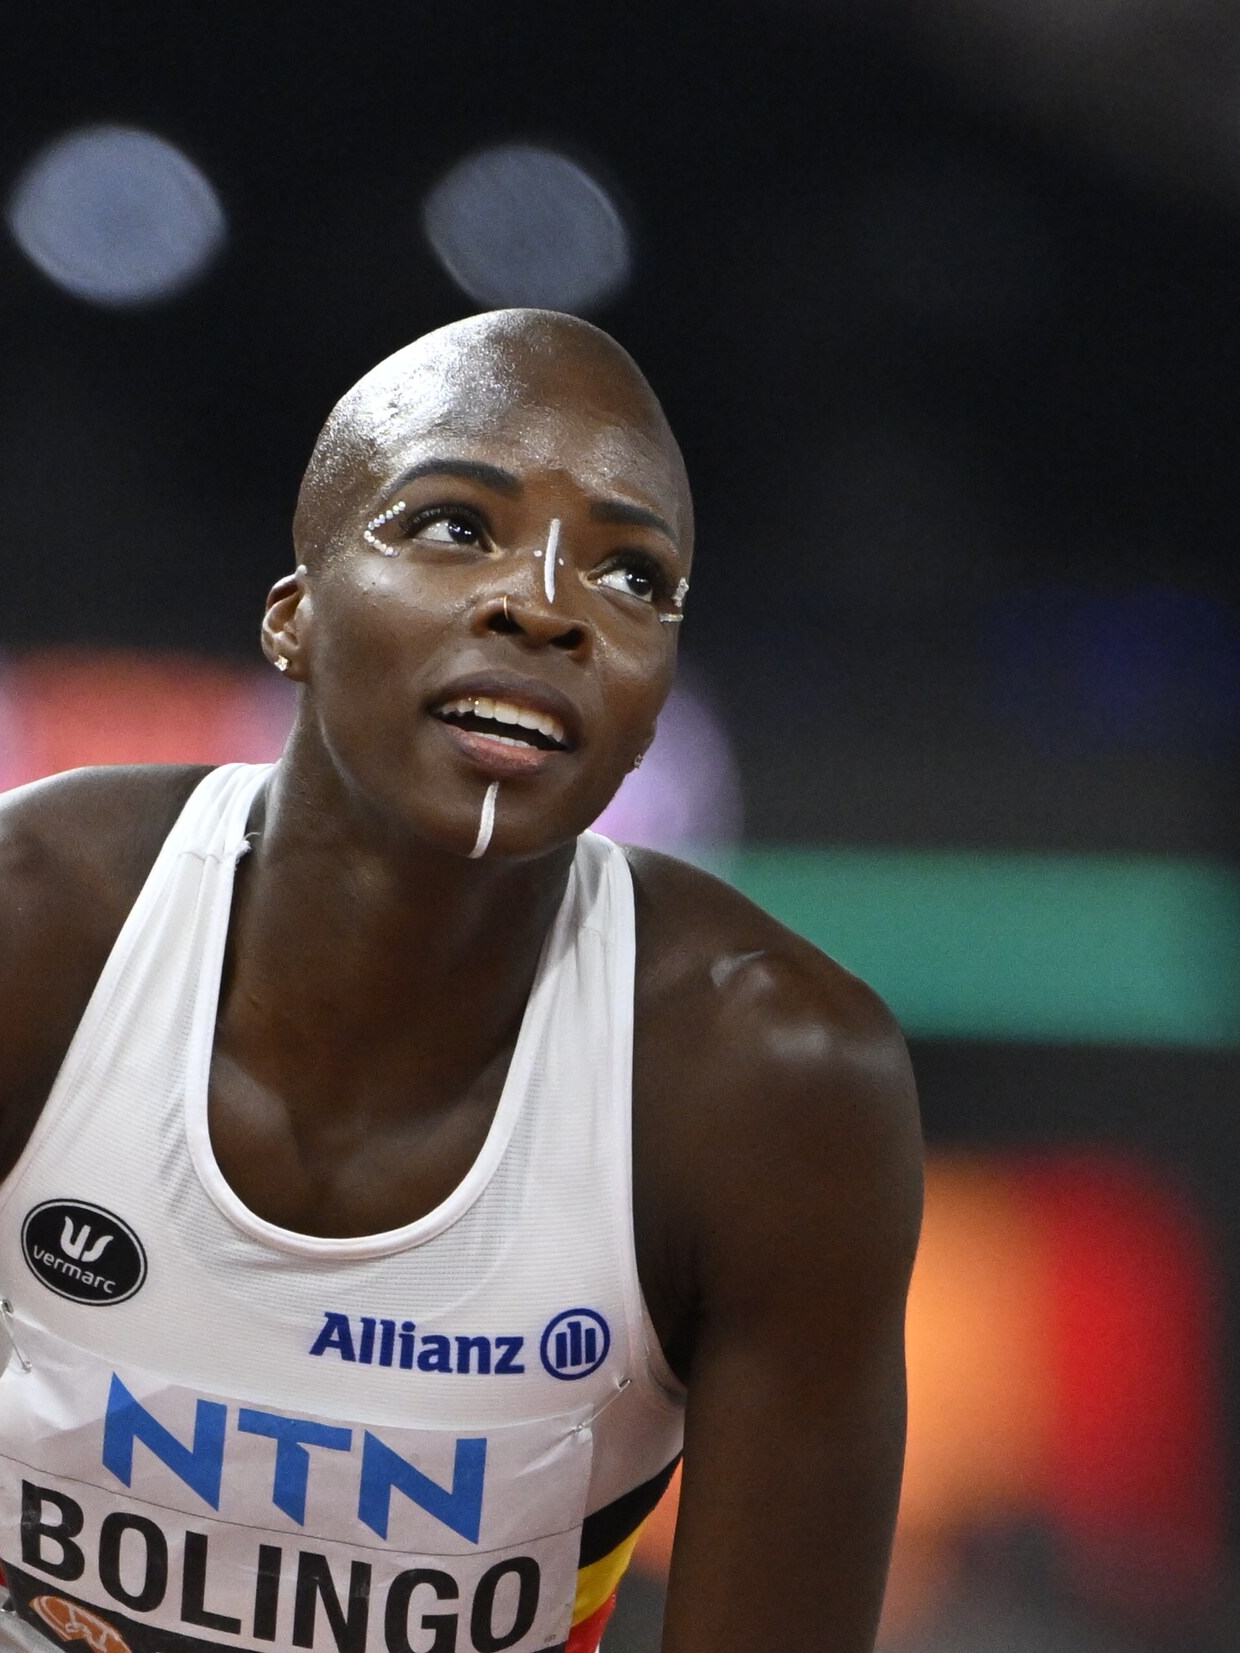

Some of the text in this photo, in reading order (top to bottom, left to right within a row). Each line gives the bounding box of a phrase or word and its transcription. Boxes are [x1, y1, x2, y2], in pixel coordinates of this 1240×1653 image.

[32, 1245, 116, 1293] vermarc
[309, 1312, 525, 1374] Allianz
[102, 1371, 487, 1545] NTN
[20, 1480, 541, 1653] BOLINGO
